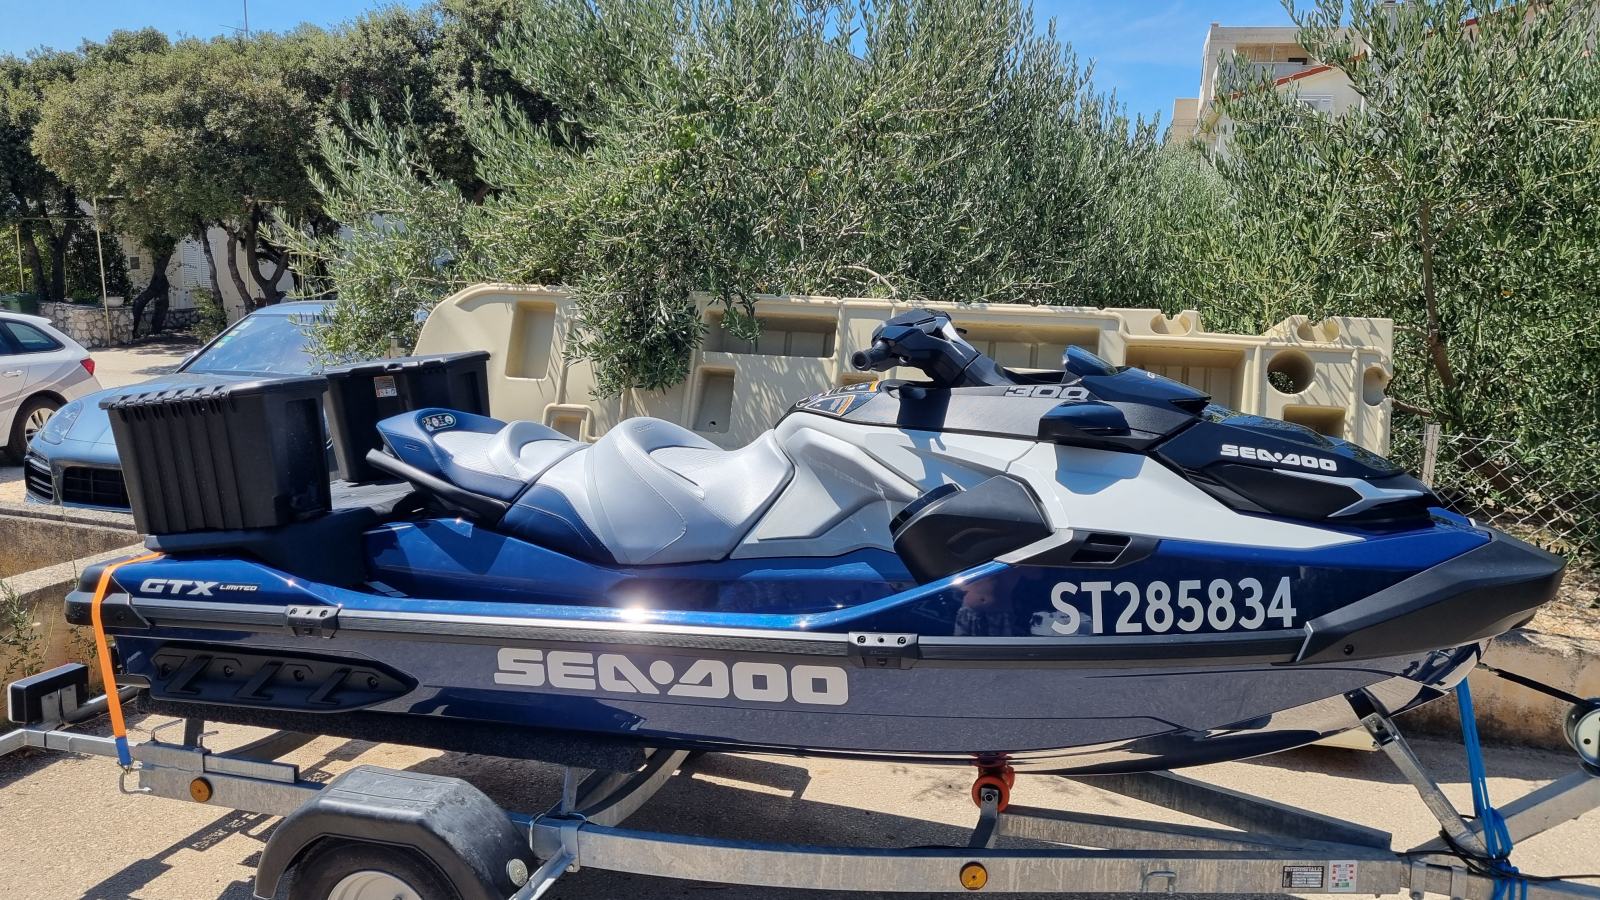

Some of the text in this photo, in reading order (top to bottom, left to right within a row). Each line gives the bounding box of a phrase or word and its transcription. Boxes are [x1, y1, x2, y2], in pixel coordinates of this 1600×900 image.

[1005, 385, 1091, 401] 300
[139, 578, 258, 596] GTX LIMITED
[1050, 576, 1297, 635] ST285834
